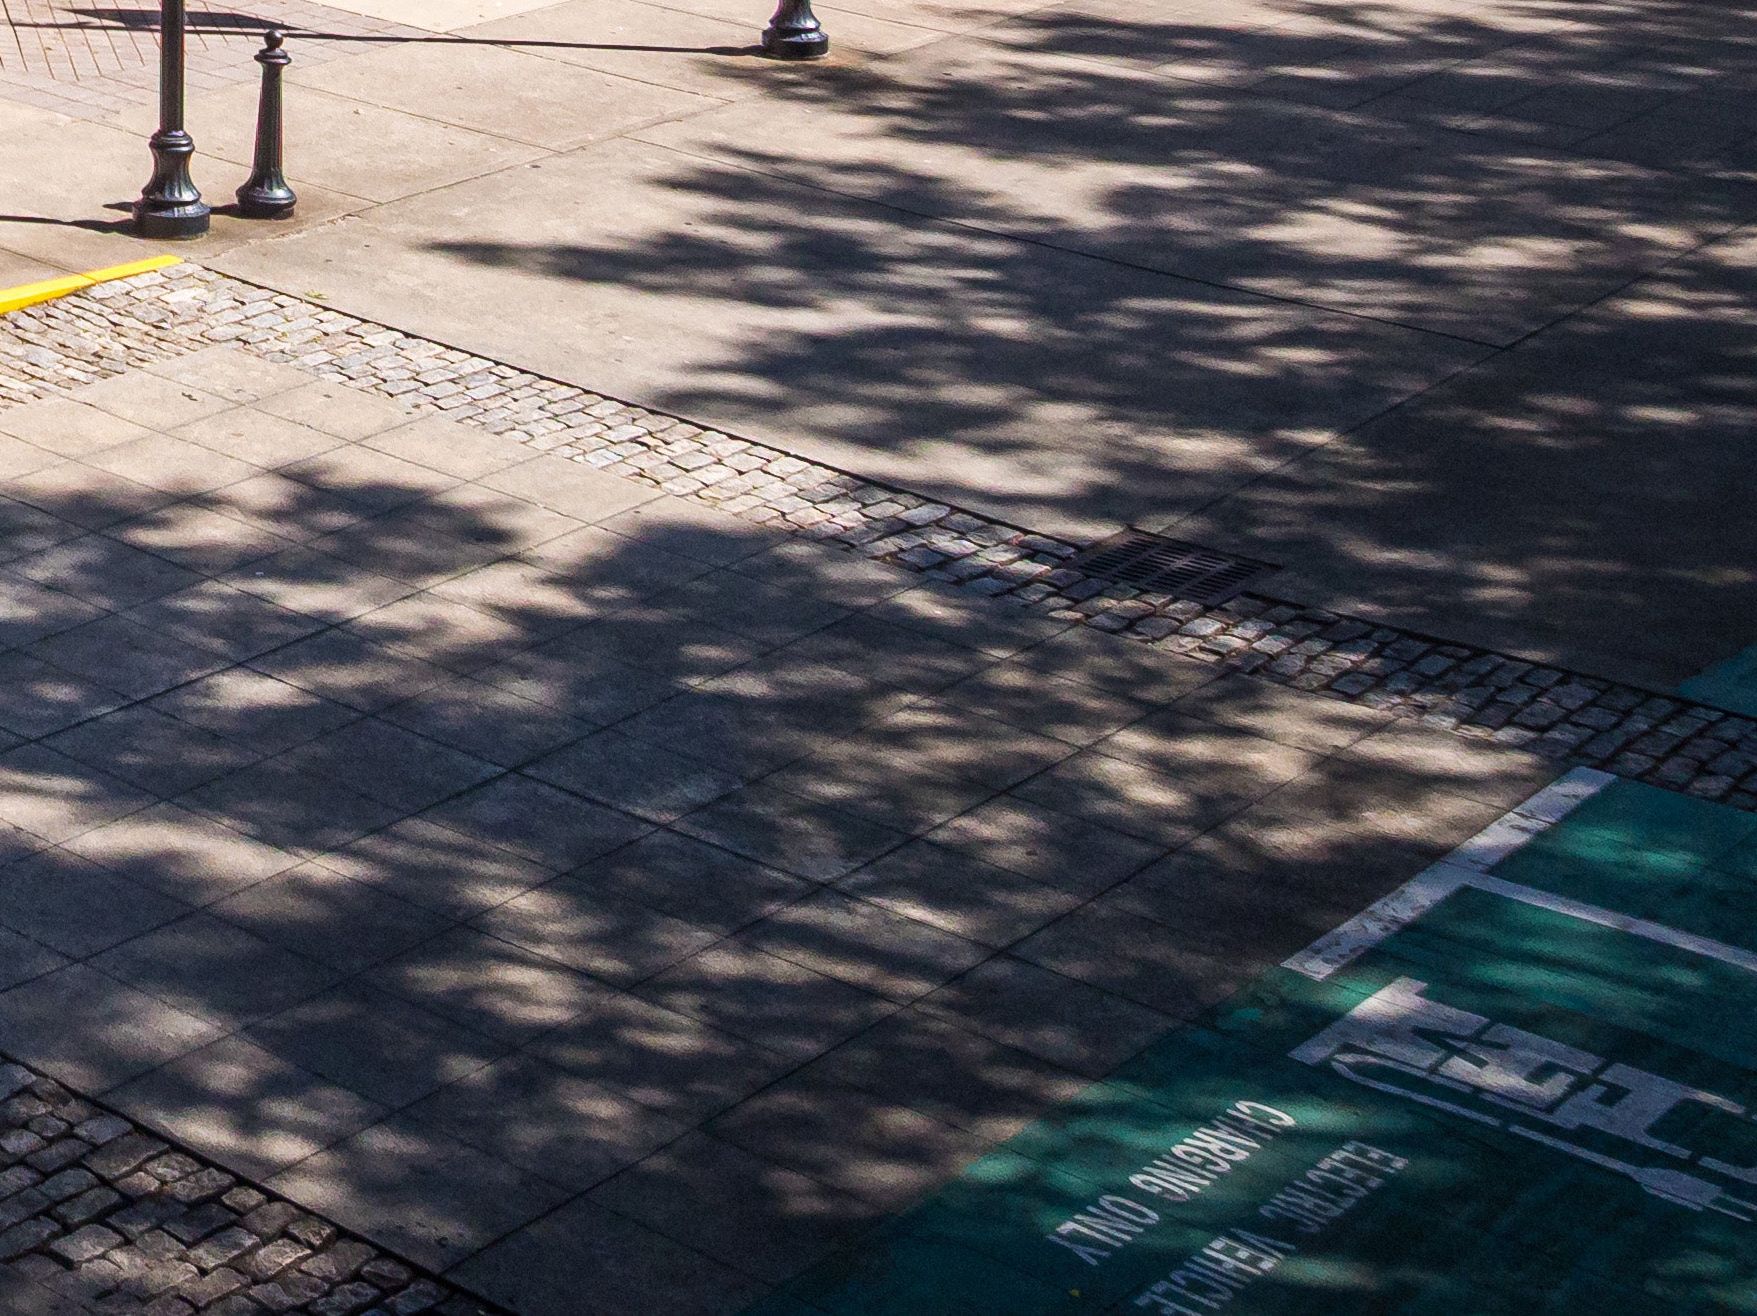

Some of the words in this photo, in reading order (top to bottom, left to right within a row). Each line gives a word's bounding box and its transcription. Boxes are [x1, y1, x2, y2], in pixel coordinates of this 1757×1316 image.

[1128, 1099, 1297, 1202] CHARGING
[1258, 1139, 1410, 1234] ELECTRIC
[1045, 1193, 1161, 1266] ONLY
[1133, 1227, 1297, 1316] VEHICLE
